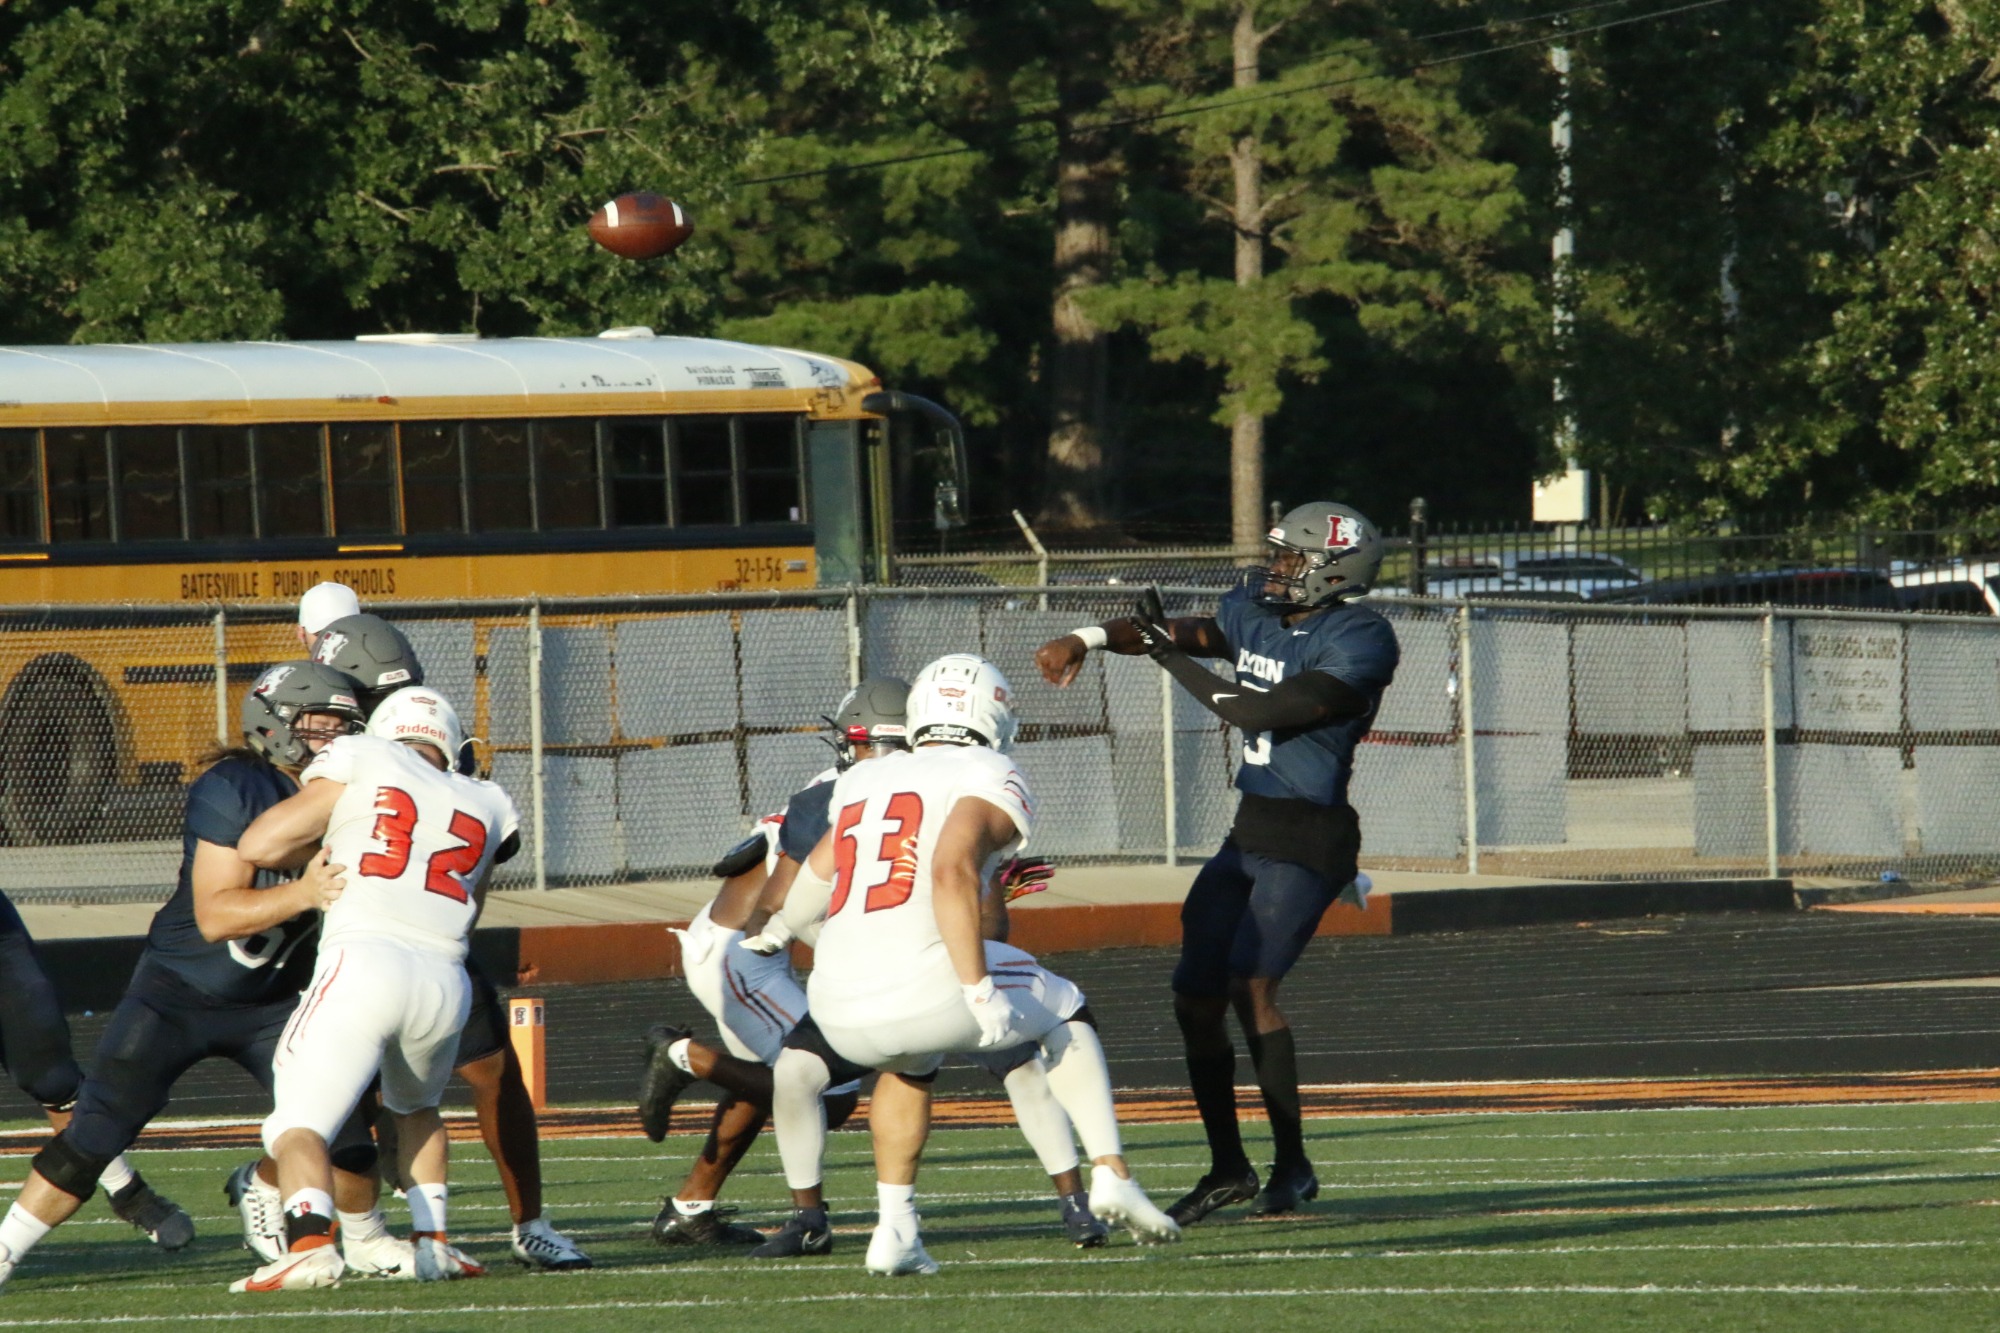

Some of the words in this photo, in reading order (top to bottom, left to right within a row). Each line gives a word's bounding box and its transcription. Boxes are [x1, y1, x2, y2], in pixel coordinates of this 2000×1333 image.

[181, 572, 259, 600] BATESVILLE
[273, 570, 320, 597] PUBLIC
[333, 568, 396, 595] SCHOOLS
[736, 557, 782, 582] 32-1-56
[1236, 648, 1285, 684] LYON
[395, 723, 447, 741] Riddell
[359, 786, 487, 905] 32
[828, 791, 923, 919] 53
